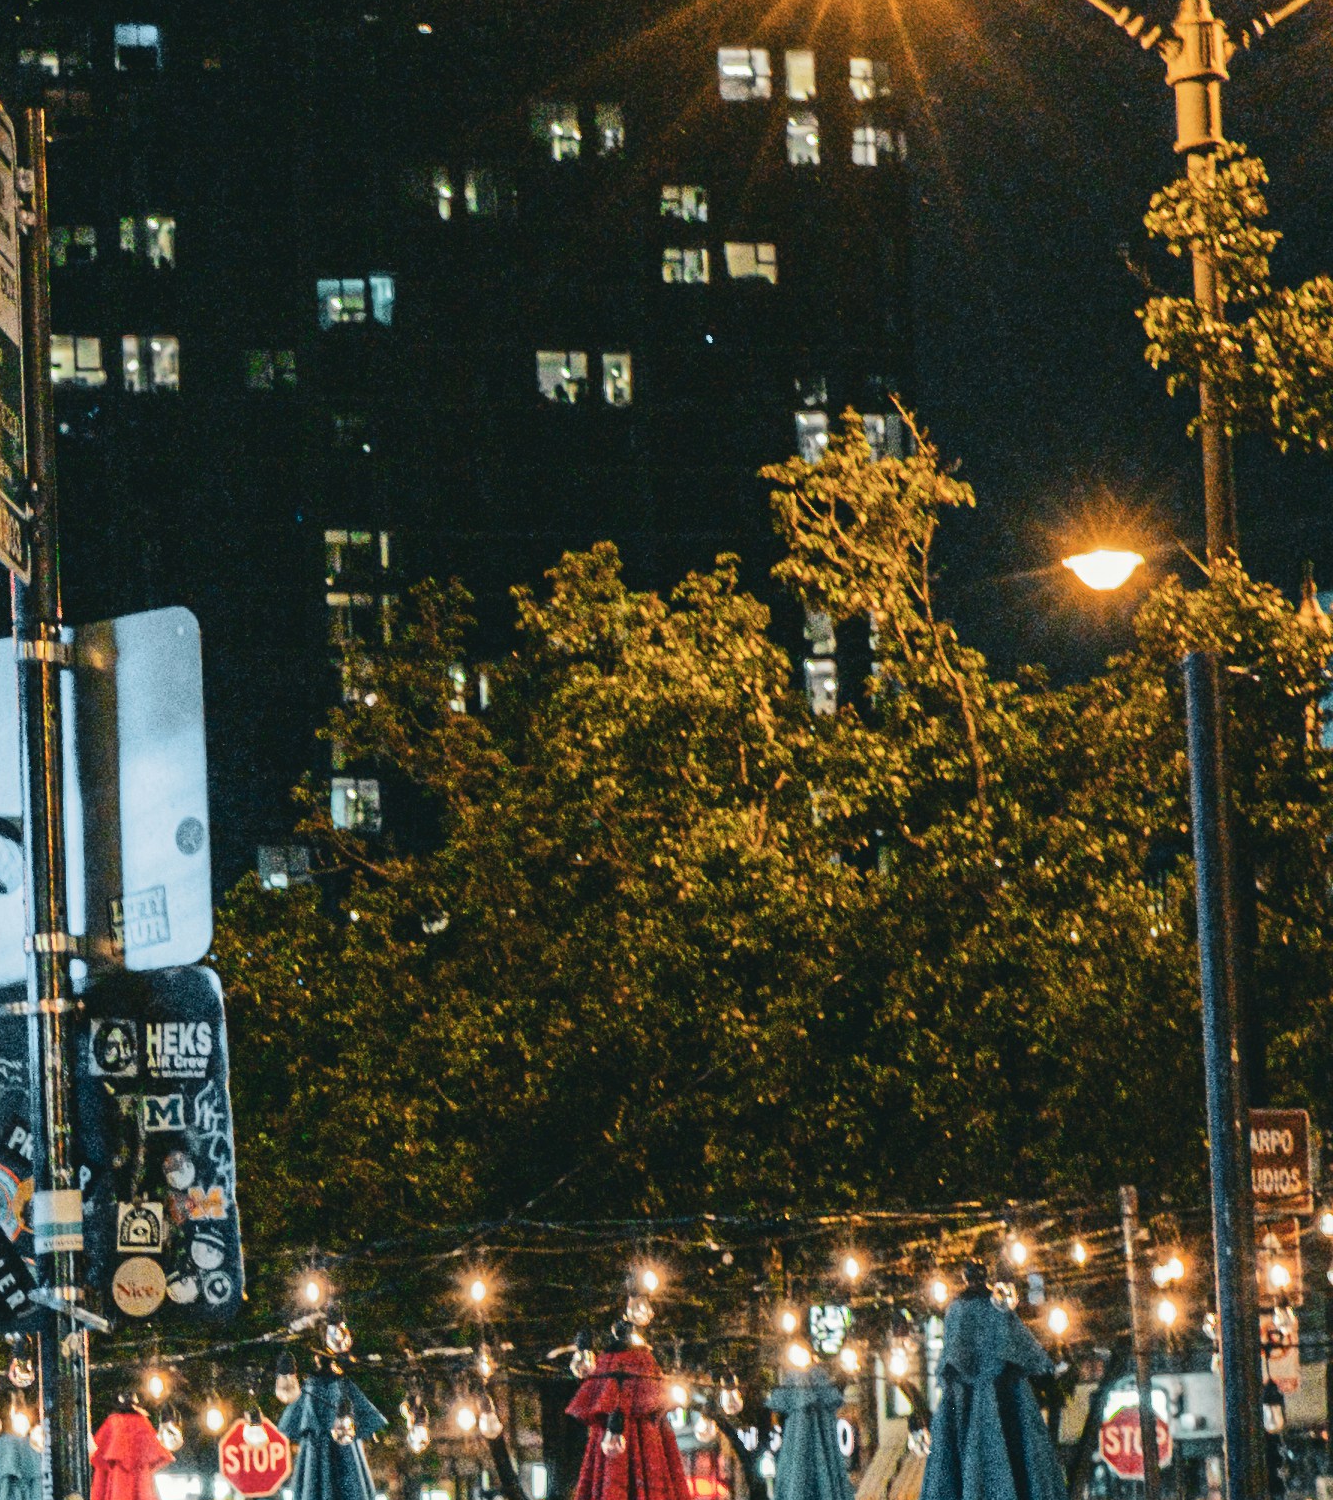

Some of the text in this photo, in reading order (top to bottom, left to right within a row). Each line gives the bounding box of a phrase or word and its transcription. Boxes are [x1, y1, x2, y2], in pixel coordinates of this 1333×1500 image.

[145, 1022, 212, 1056] HEKS
[147, 1098, 183, 1127] M
[1250, 1129, 1294, 1154] ARPO
[1251, 1167, 1302, 1194] UDIOS
[224, 1444, 285, 1474] STOP
